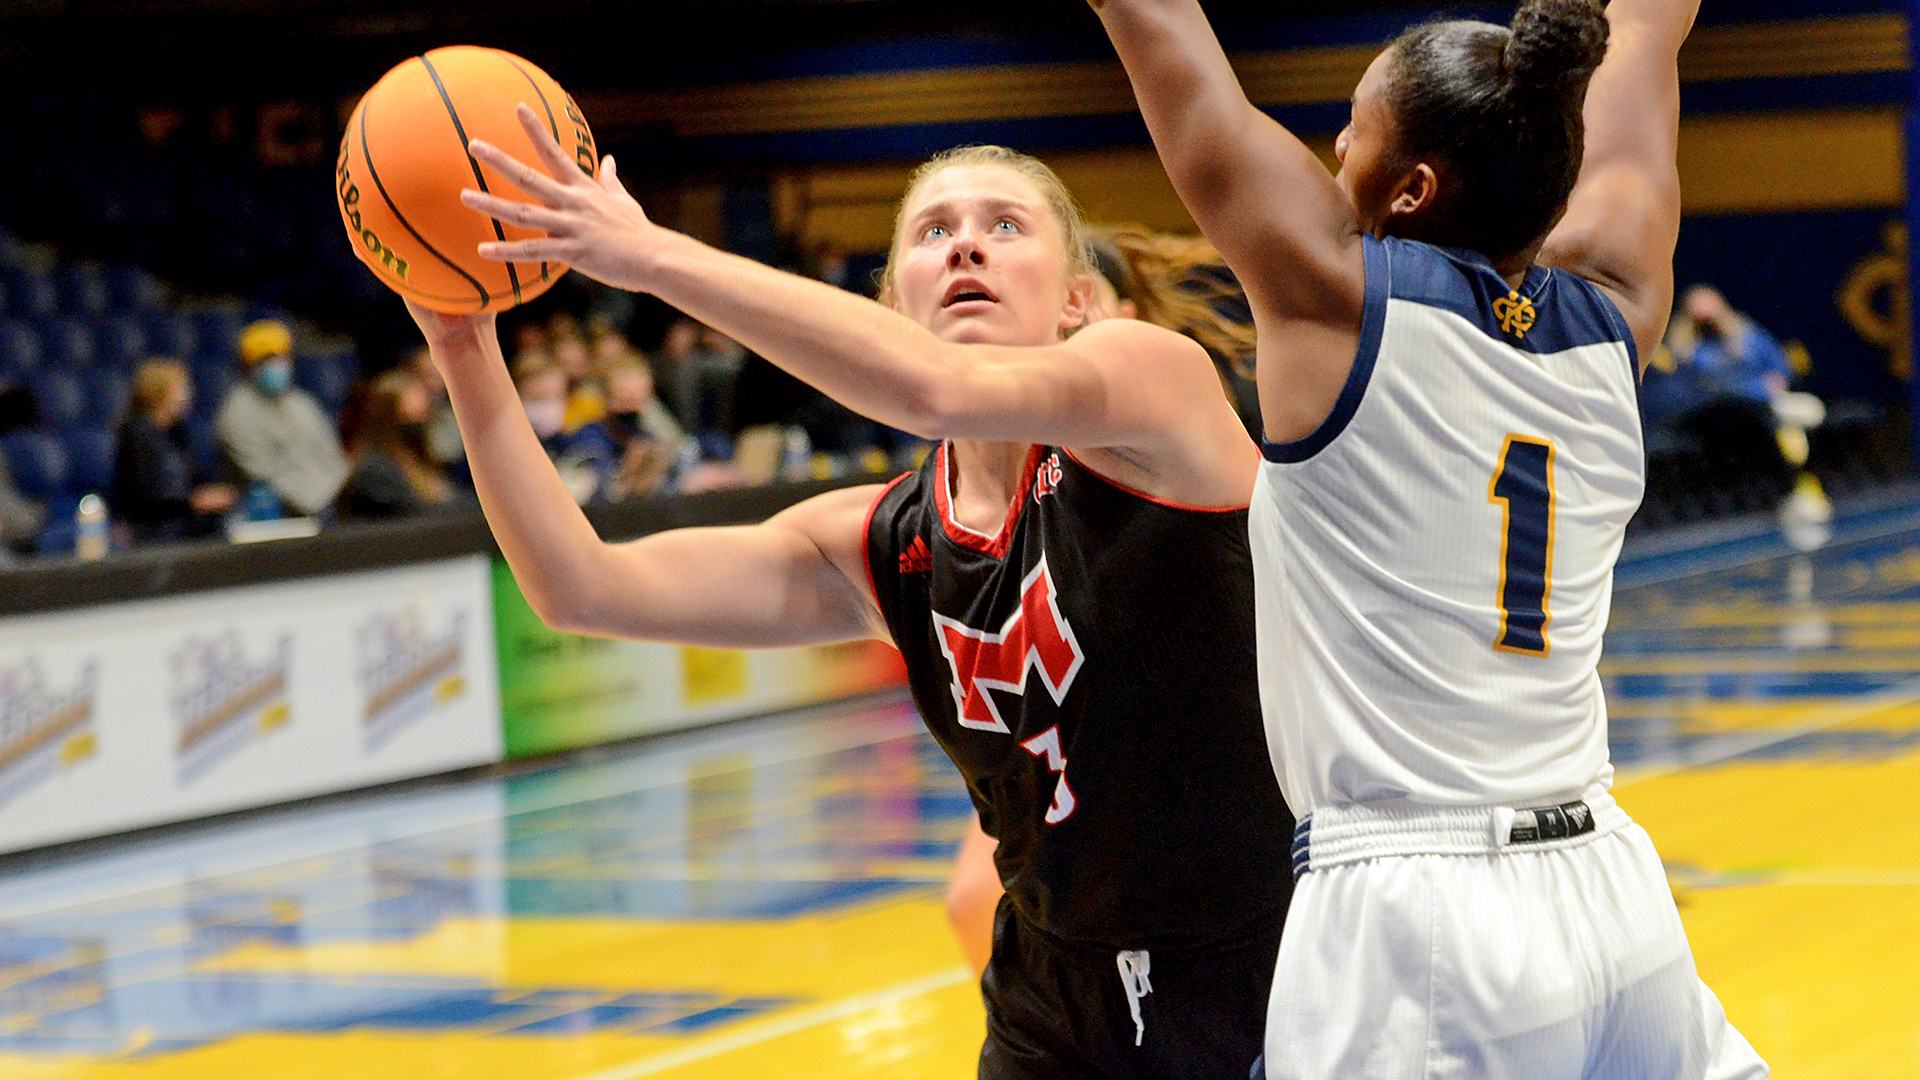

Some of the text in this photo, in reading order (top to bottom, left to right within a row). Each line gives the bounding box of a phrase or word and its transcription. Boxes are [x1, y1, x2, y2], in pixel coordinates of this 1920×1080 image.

[1487, 432, 1556, 659] 1
[931, 549, 1085, 734] M
[1019, 723, 1077, 826] 3
